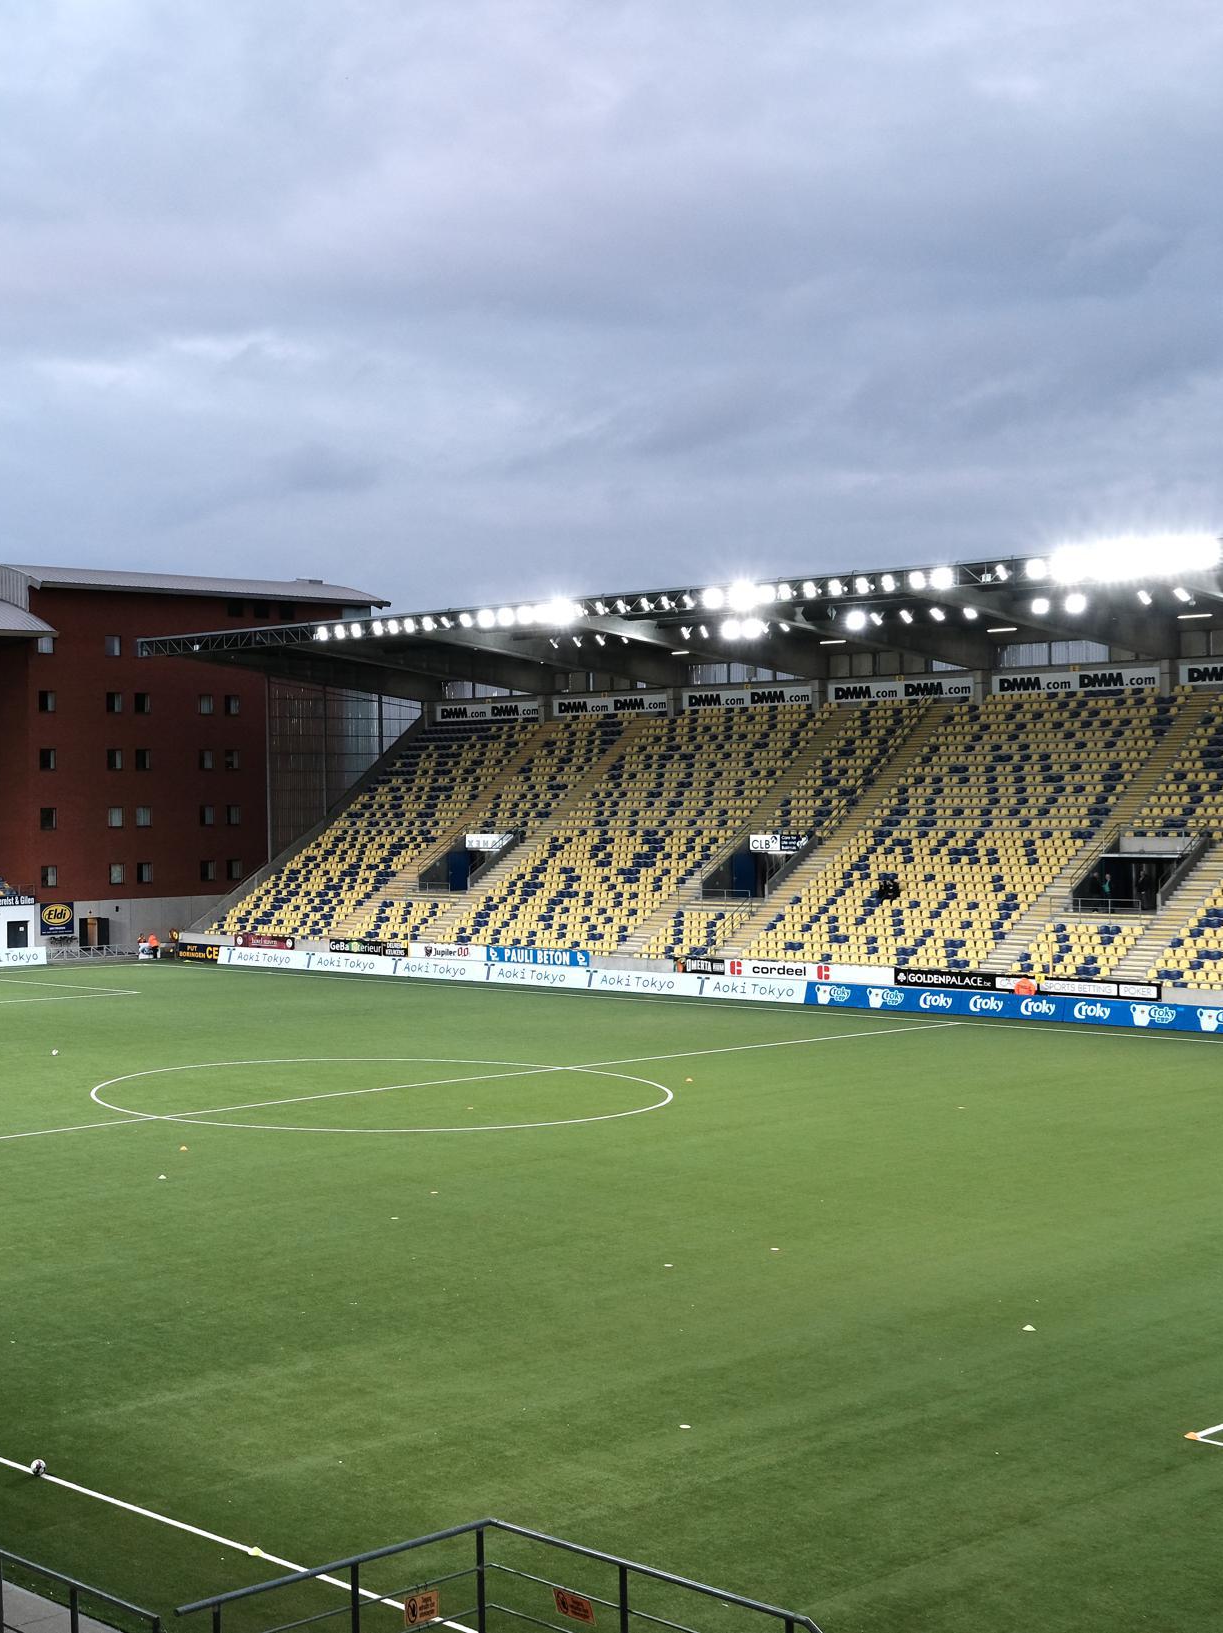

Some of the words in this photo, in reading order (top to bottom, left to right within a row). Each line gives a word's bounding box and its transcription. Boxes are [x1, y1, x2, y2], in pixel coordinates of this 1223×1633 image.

[999, 677, 1071, 692] DMM.com
[1079, 673, 1156, 688] DMM.com
[834, 686, 898, 700] DMM.com
[904, 682, 971, 697] DMM.com
[558, 702, 607, 713] DMM.com
[613, 698, 666, 711] DMM.com
[688, 694, 744, 707] DMM.com
[750, 690, 809, 704] DMM.com
[441, 708, 487, 719] DMM.com
[490, 705, 538, 717] DMM.com
[751, 839, 771, 850] CLB
[47, 908, 67, 920] Eldi
[433, 948, 457, 957] Jupiler
[504, 949, 533, 963] PAULI
[536, 952, 571, 965] BETON
[752, 965, 807, 977] cordeel
[829, 987, 851, 998] Croky
[1045, 982, 1076, 993] SPORTS
[1078, 984, 1113, 994] BETTING
[1124, 986, 1152, 997] POKER
[881, 990, 904, 1001] Croky
[918, 992, 953, 1009] Croky
[969, 995, 1004, 1012] Croky
[1020, 998, 1056, 1016] Croky
[1074, 1001, 1111, 1020] Croky
[1149, 1006, 1175, 1019] Croky
